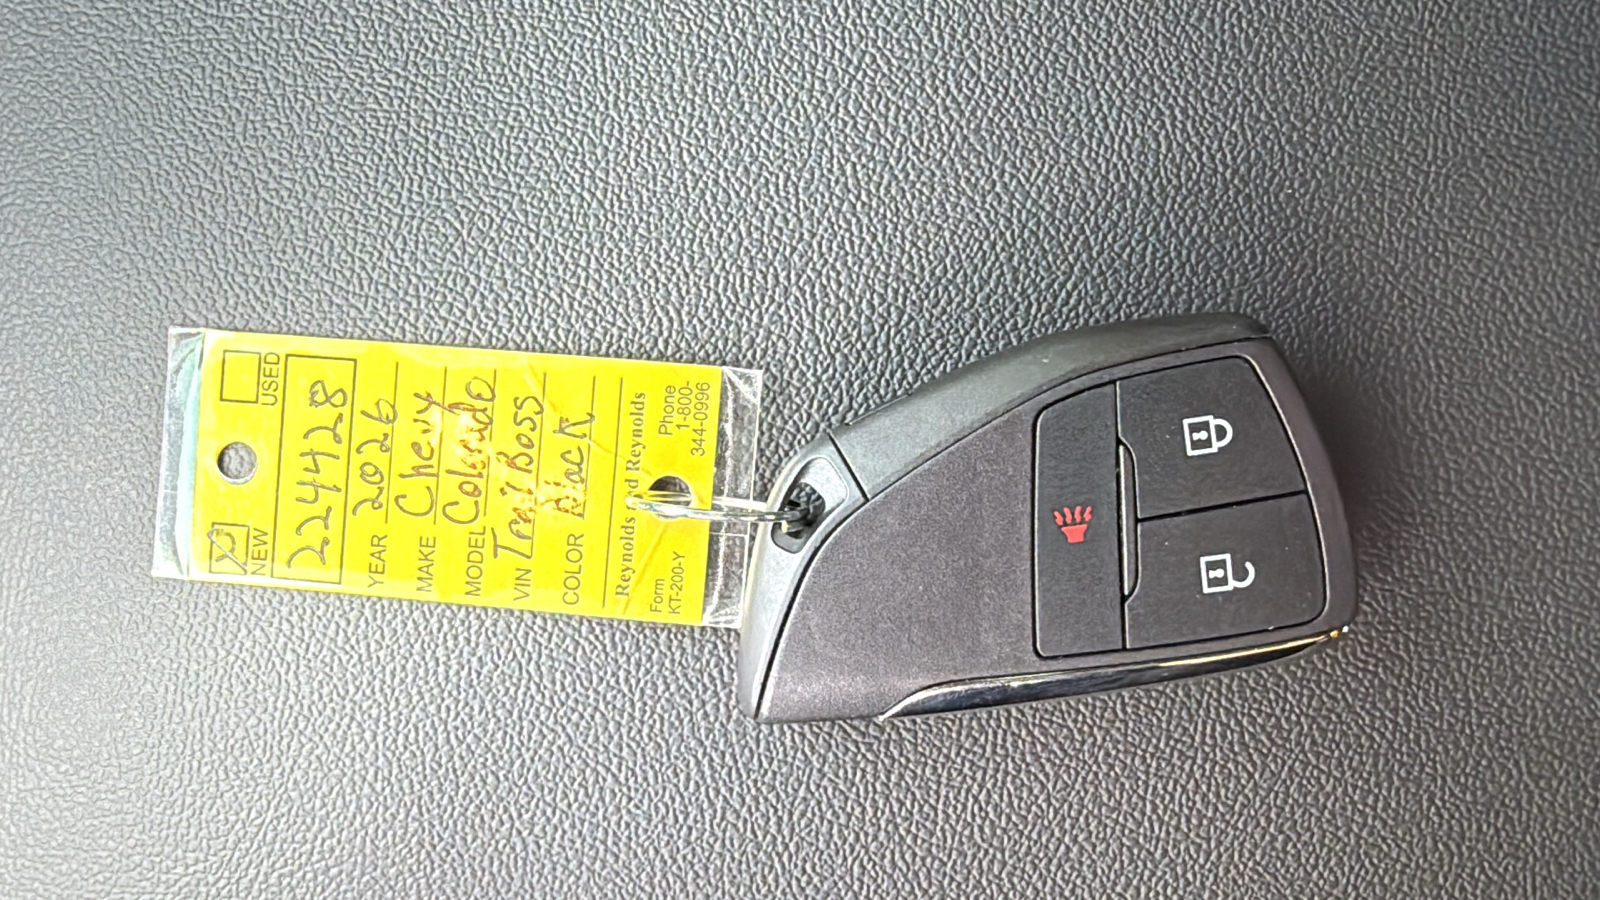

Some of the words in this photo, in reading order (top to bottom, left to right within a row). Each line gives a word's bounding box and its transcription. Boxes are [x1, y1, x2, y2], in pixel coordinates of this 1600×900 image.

[260, 352, 280, 406] USED
[676, 380, 694, 430] 1-800-
[658, 384, 677, 436] Phone
[690, 381, 711, 457] 344-0996
[287, 380, 348, 569] 224428
[353, 398, 398, 516] 2026
[394, 391, 460, 517] Chevy
[615, 517, 637, 598] Reynolds
[626, 391, 647, 472] Reynolds
[250, 528, 269, 576] NEW
[368, 534, 388, 588] YEAR
[416, 536, 437, 592] MAKE
[465, 526, 486, 597] MODEL
[562, 533, 585, 606] COLOR
[514, 567, 532, 601] VIN
[650, 577, 665, 613] Form
[667, 551, 686, 615] KT-200-Y
